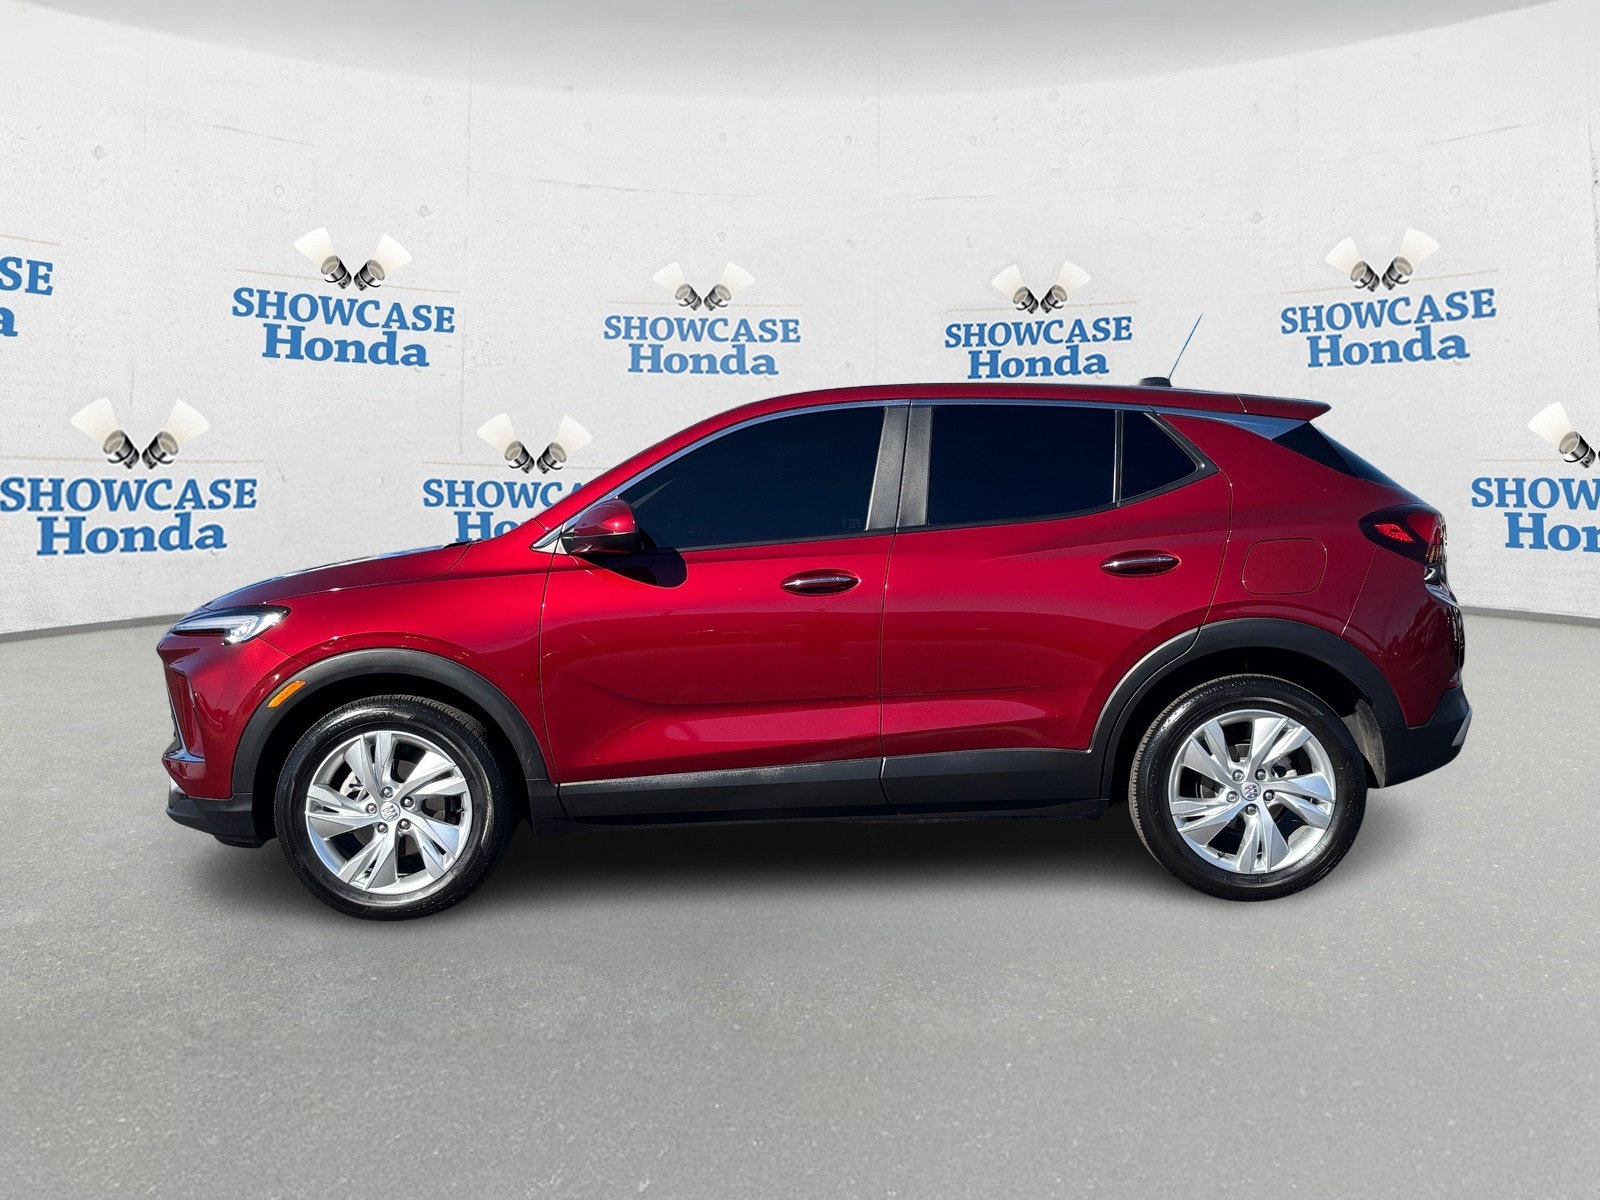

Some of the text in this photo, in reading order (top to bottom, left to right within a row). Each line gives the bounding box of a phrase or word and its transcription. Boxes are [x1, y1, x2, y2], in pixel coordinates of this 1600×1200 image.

[232, 287, 455, 334] SHOWCASE
[604, 315, 801, 344] SHOWCASE
[1281, 288, 1496, 335] SHOWCASE
[262, 322, 430, 367] Honda
[944, 315, 1133, 349] SHOWCASE
[1306, 324, 1470, 368] Honda
[628, 343, 778, 375] Honda
[967, 343, 1110, 380] Honda
[0, 477, 257, 513] SHOWCASE
[37, 511, 227, 556] Honda
